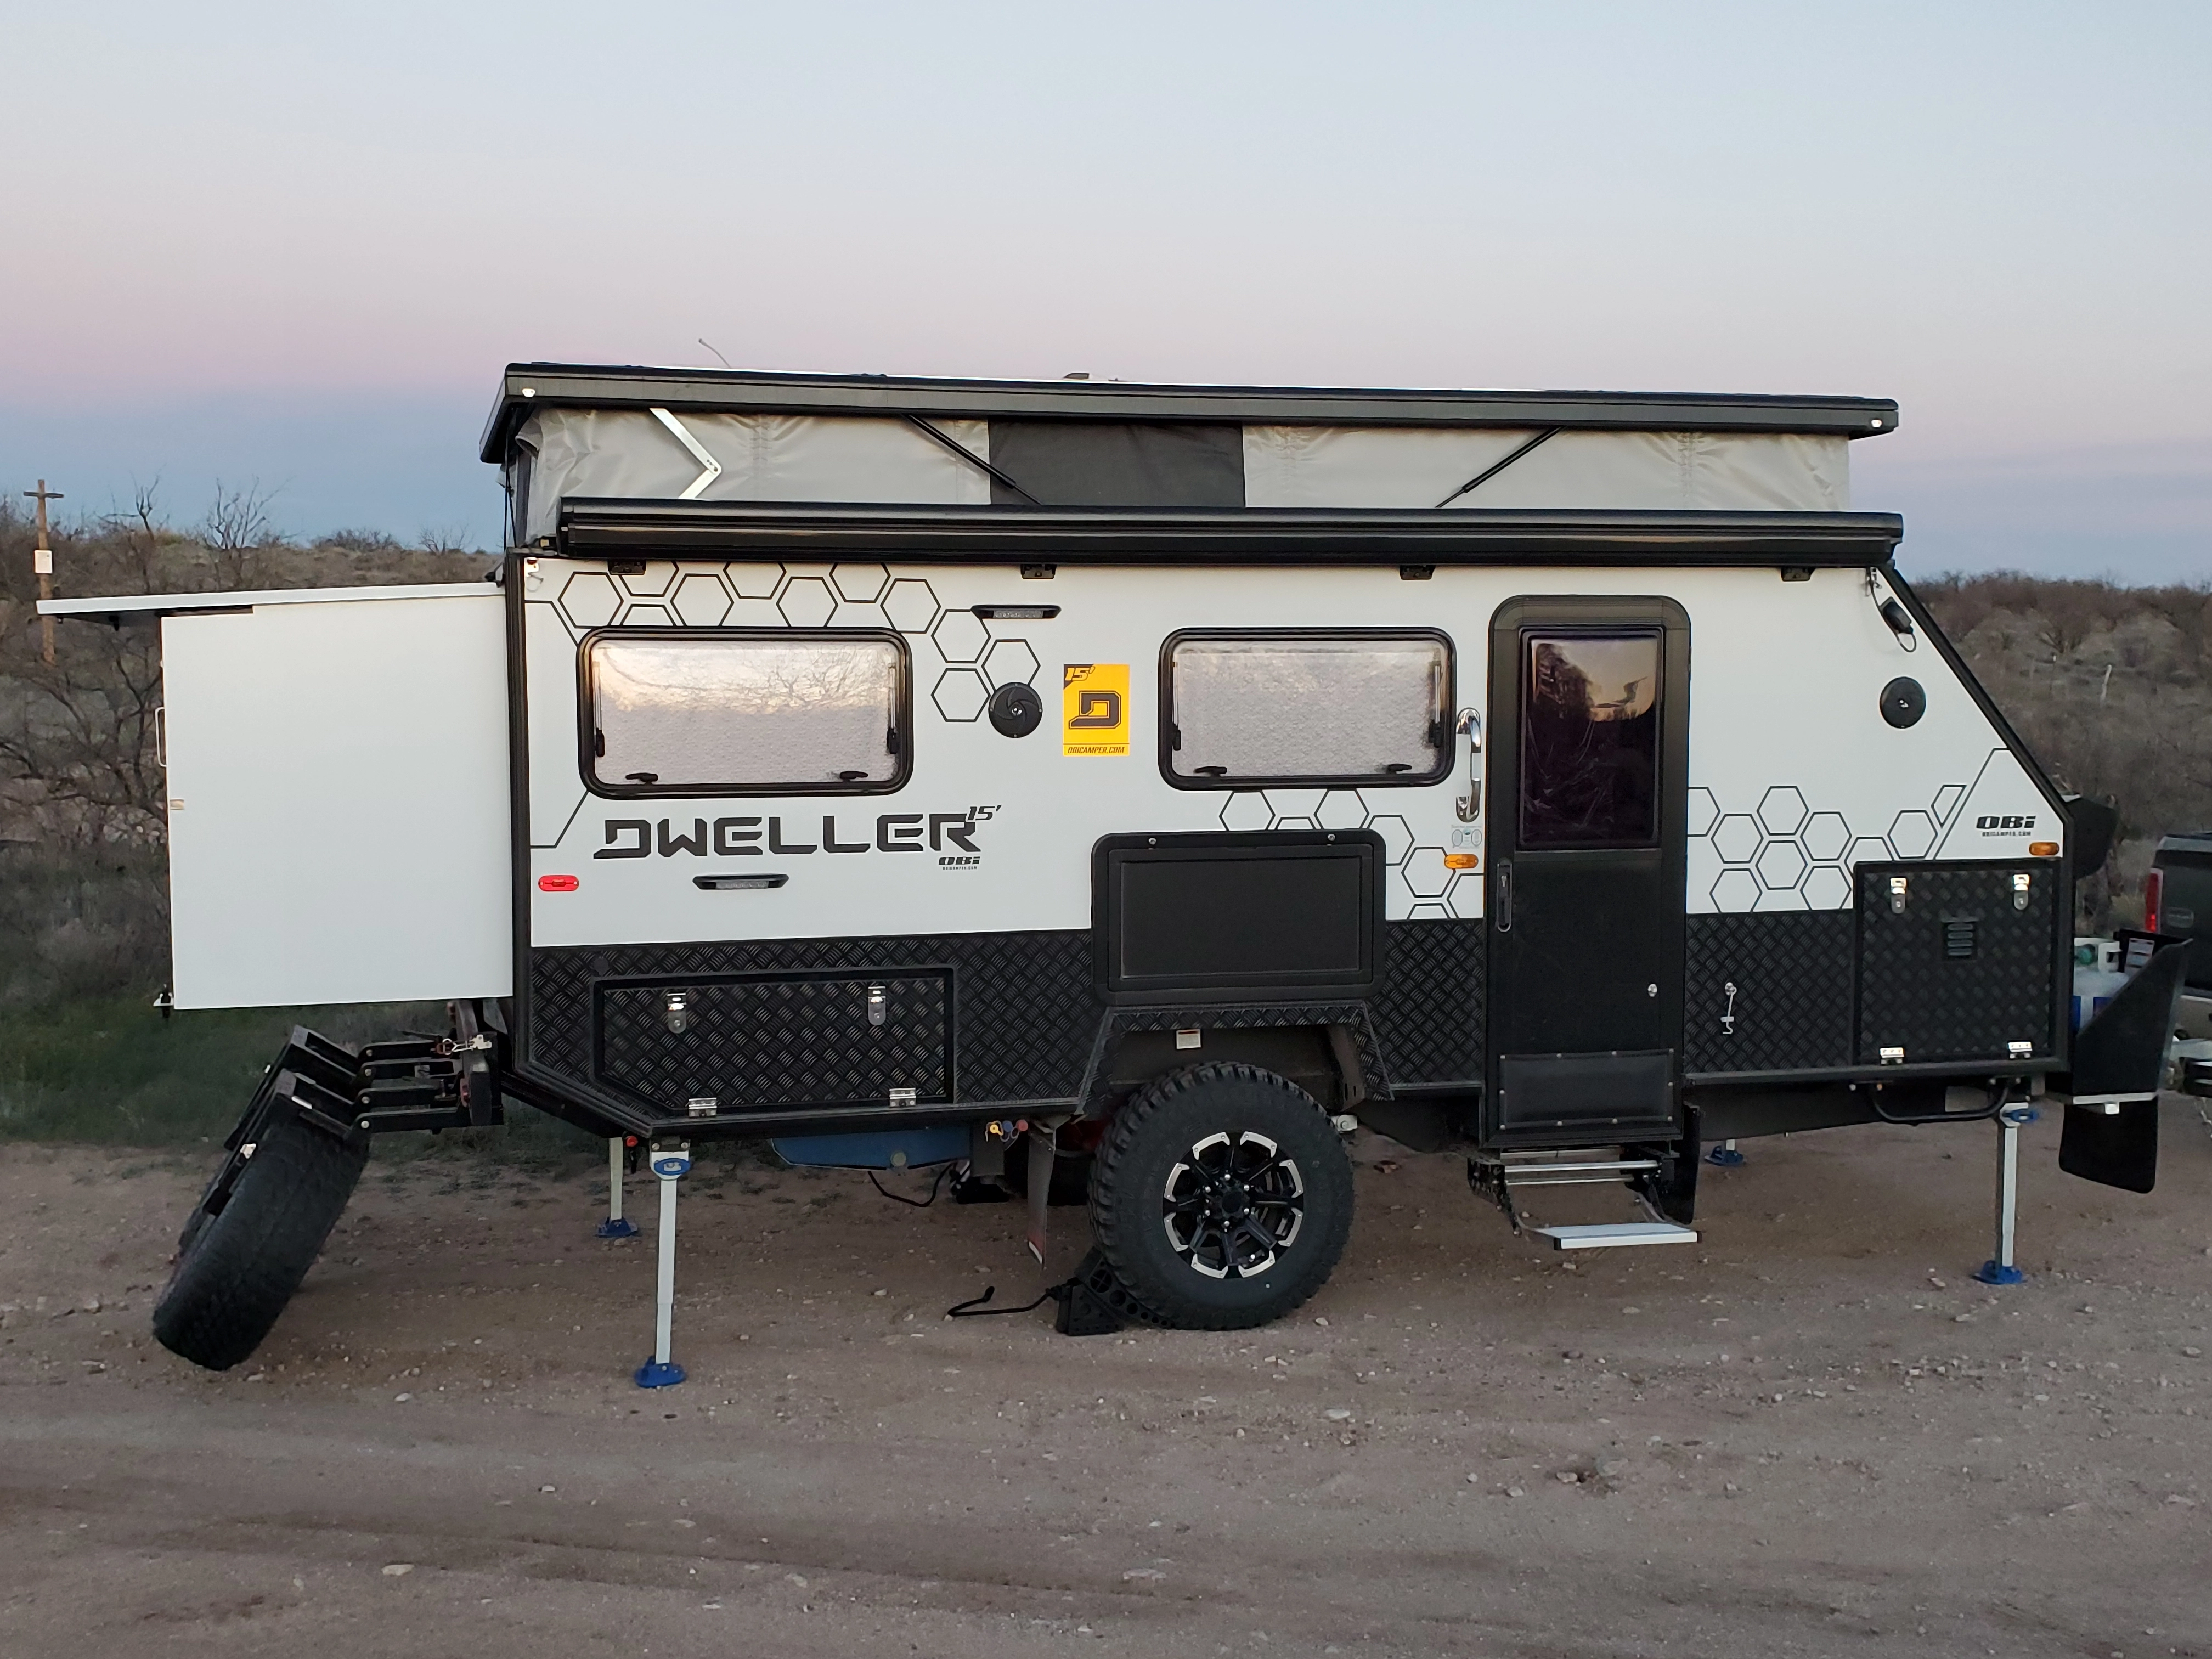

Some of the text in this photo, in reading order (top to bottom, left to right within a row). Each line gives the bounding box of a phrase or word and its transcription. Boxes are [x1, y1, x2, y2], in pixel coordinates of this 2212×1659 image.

[1065, 666, 1096, 681] 15'
[967, 804, 1002, 821] 15'
[593, 813, 981, 859] DWELLER
